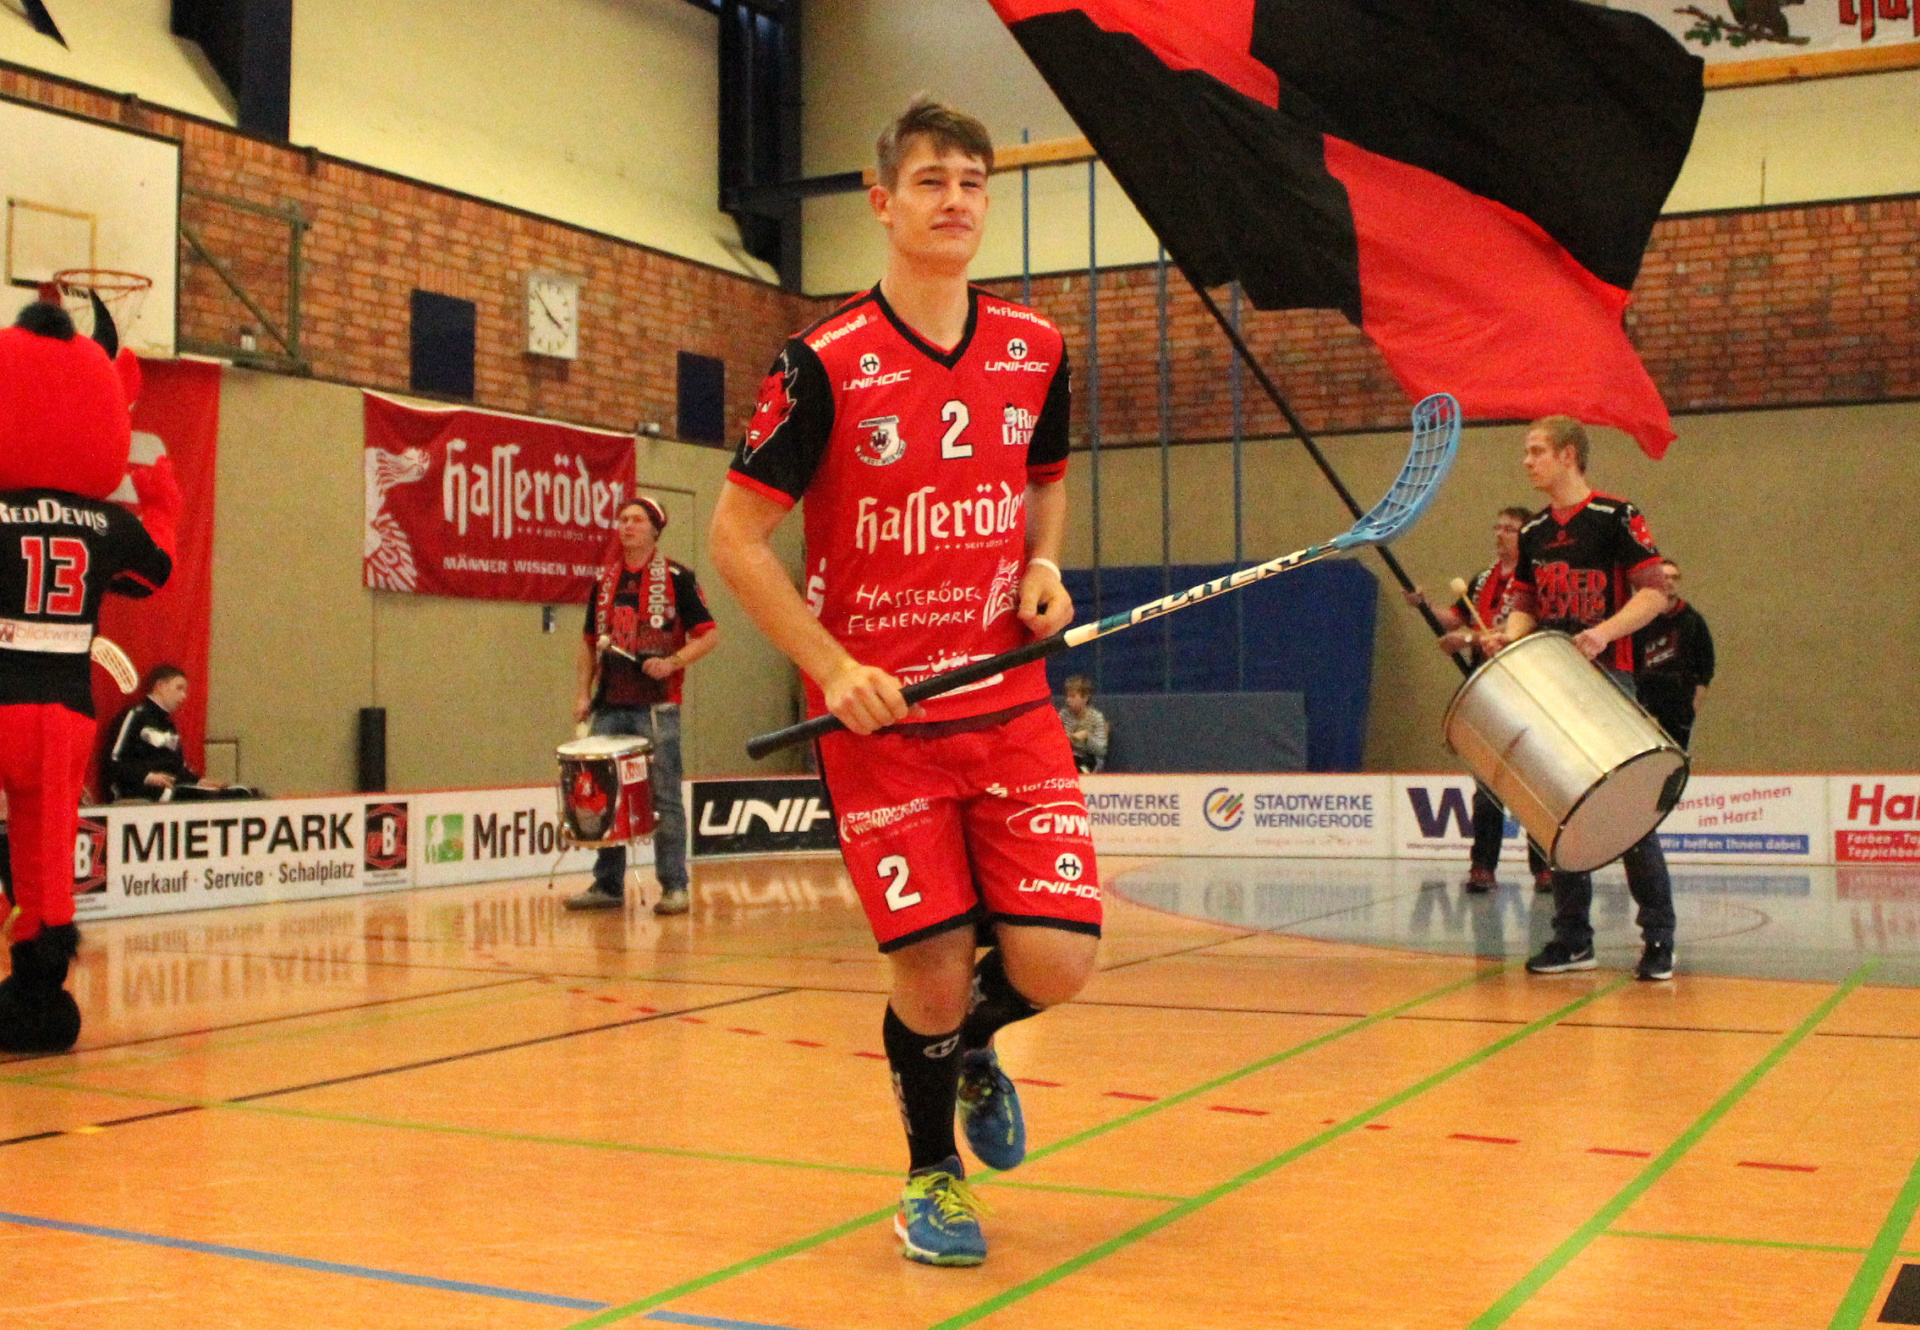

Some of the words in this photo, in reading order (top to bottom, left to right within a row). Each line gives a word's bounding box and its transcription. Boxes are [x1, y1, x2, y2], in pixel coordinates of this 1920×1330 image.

[984, 361, 1050, 372] UNIHOC
[843, 369, 911, 390] UNIHOC
[941, 400, 973, 459] 2
[20, 536, 88, 616] 13
[848, 610, 976, 634] FERIENPARK
[1254, 795, 1373, 811] STADTWERKE
[1729, 786, 1792, 804] wohnen
[1847, 784, 1920, 826] Ha
[1254, 813, 1373, 828] WERNIGERODE
[1698, 814, 1718, 828] im
[1723, 807, 1764, 824] Harz!
[121, 813, 355, 864] MIETPARK
[121, 871, 188, 896] Verkauf
[203, 868, 263, 890] Service
[278, 861, 355, 884] Schalplatz
[876, 854, 922, 913] 2
